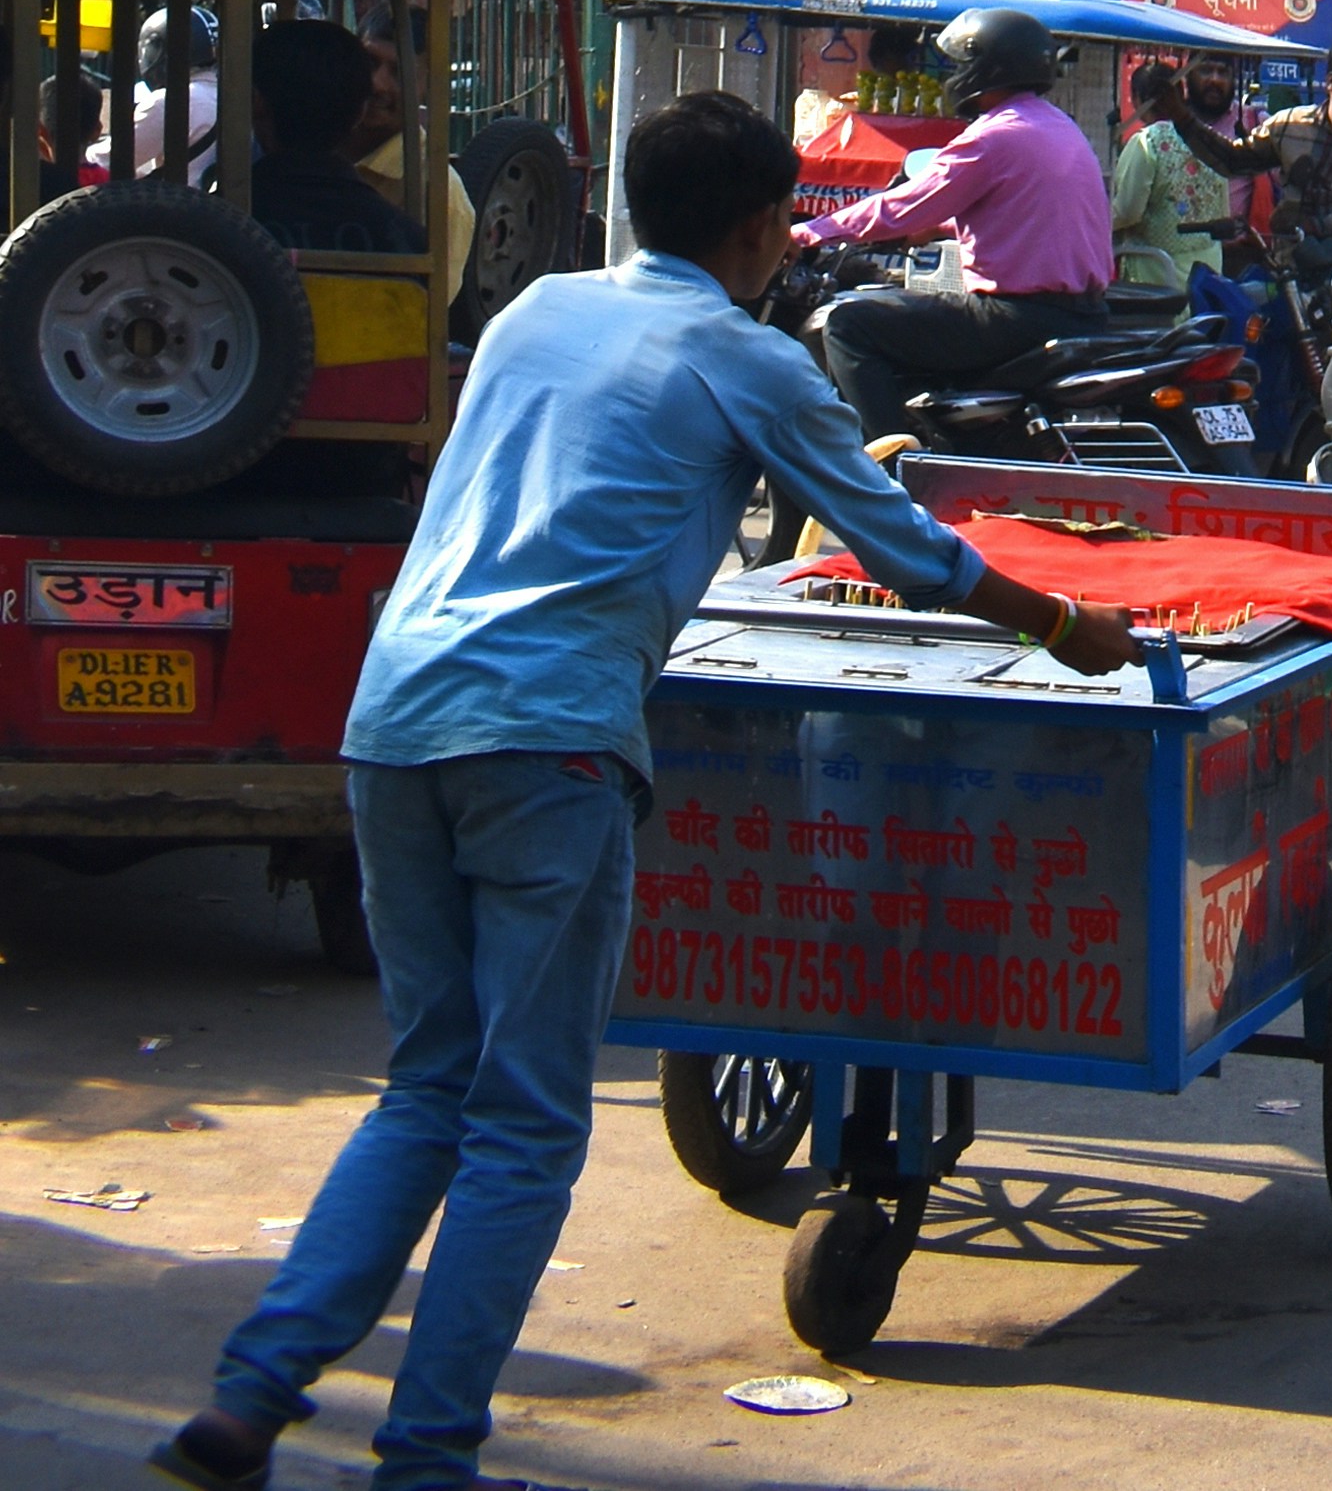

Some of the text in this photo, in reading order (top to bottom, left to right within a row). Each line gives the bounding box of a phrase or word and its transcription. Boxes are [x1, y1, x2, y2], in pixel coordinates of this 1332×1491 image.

[36, 569, 225, 621] उड़ान
[820, 752, 863, 782] की
[732, 803, 772, 853] की
[786, 808, 871, 862] तारीफ
[989, 819, 1017, 873] से
[632, 864, 713, 921] कुल्फी
[726, 869, 763, 917] की
[776, 872, 857, 925] तारीफ
[869, 878, 931, 929] खाने
[1026, 886, 1055, 941] से
